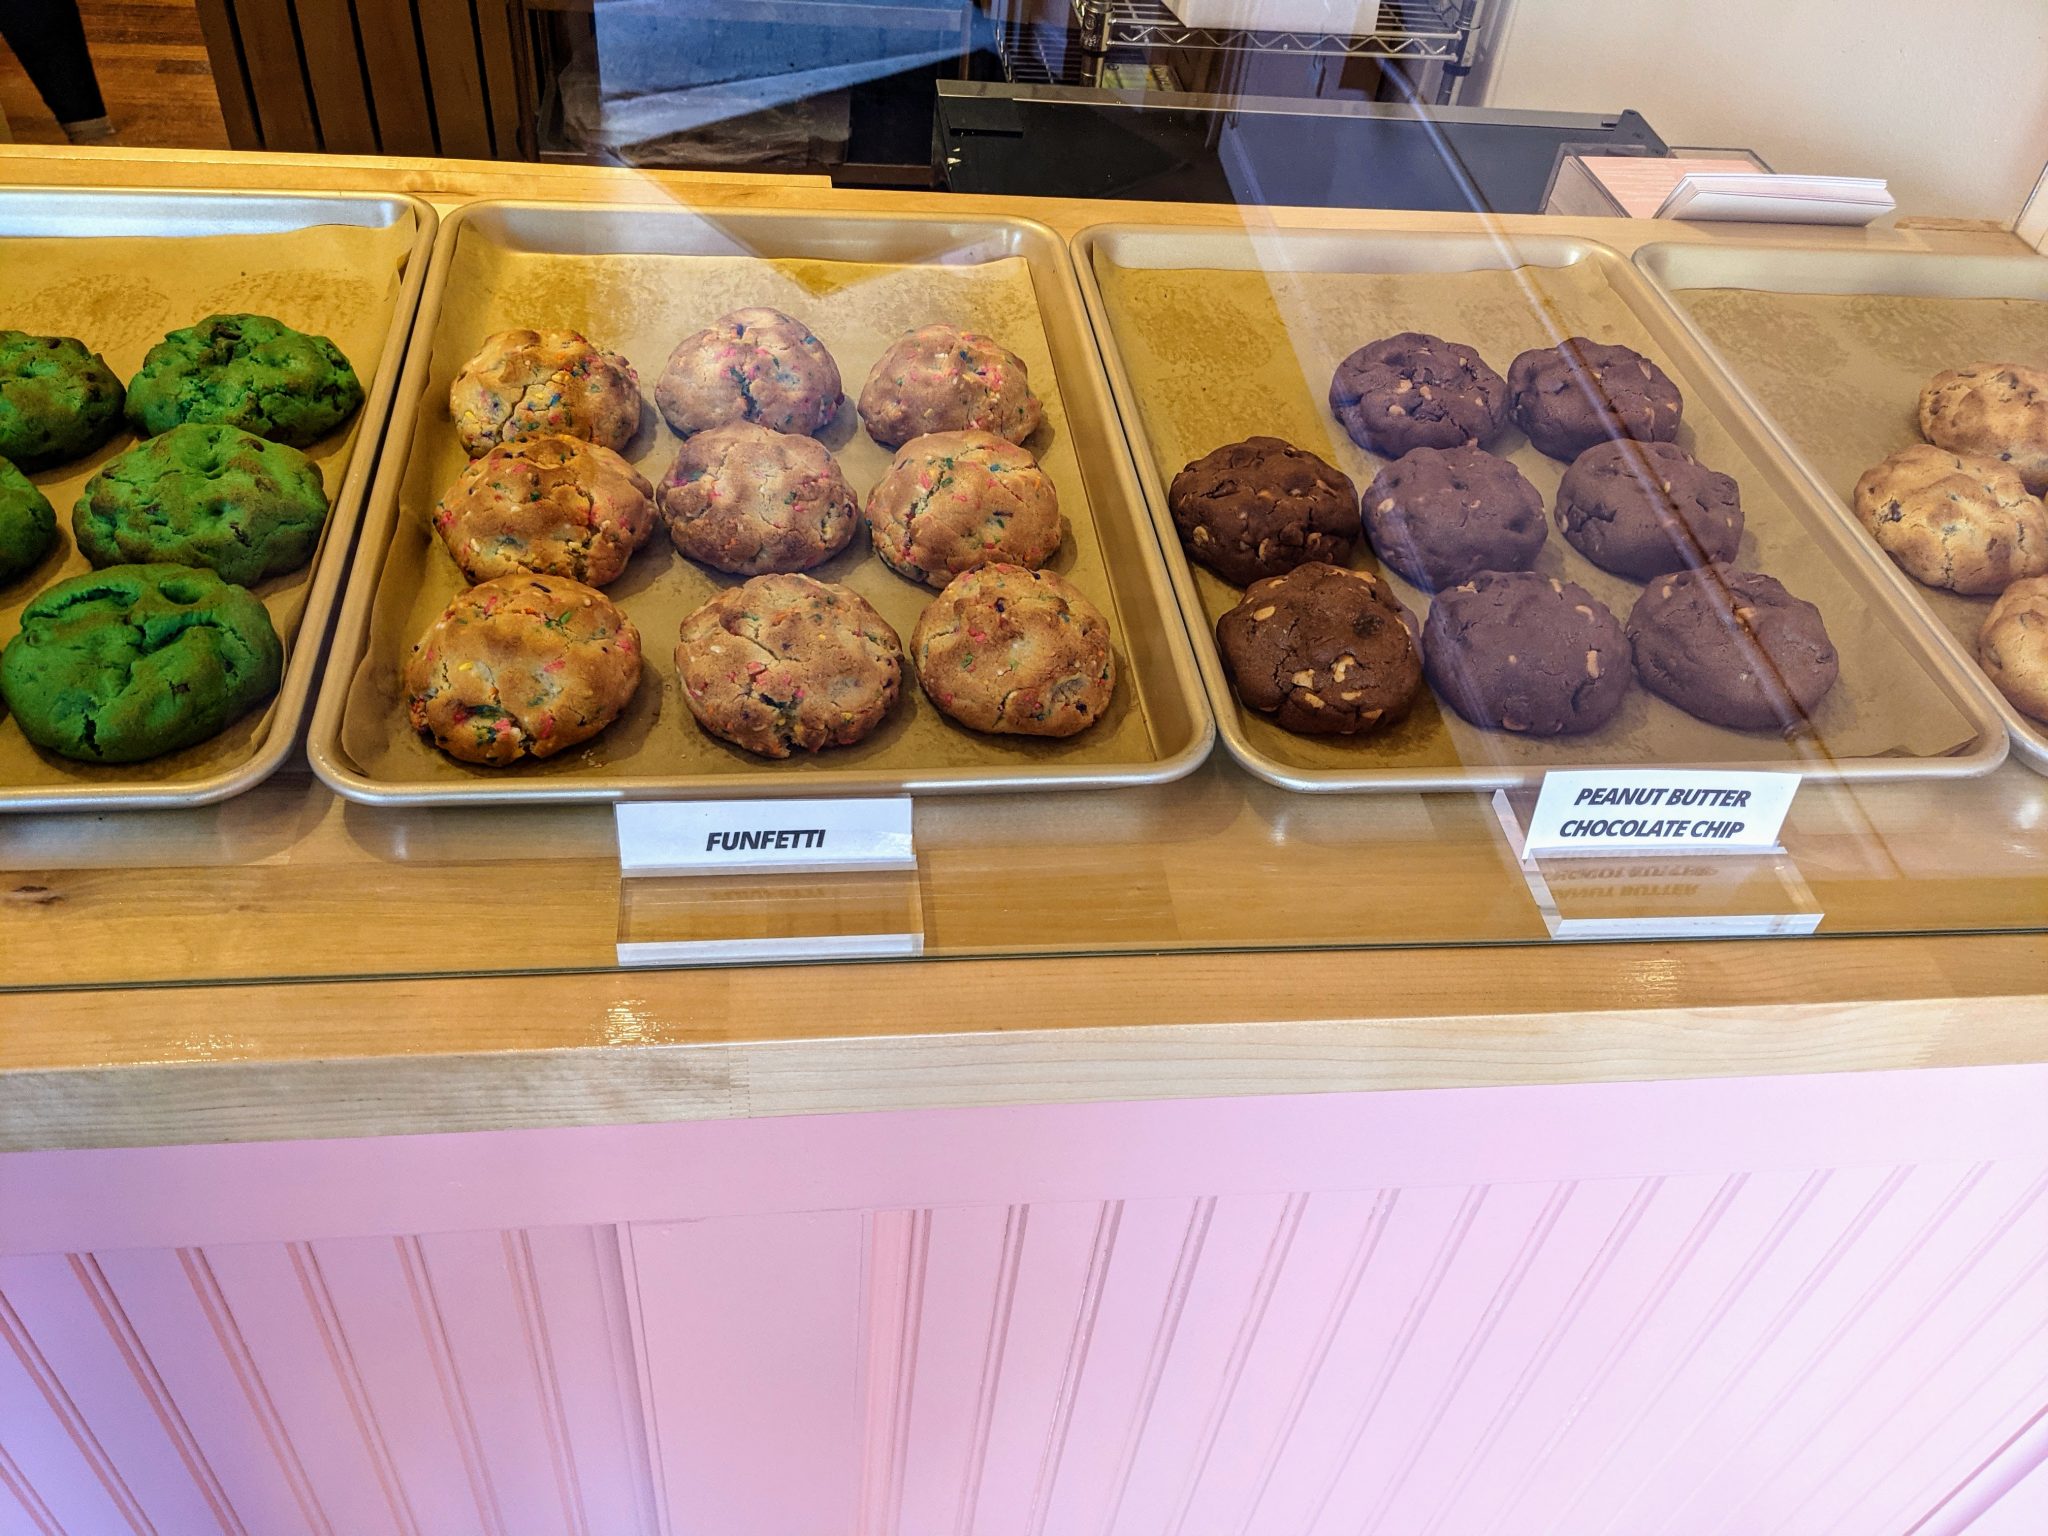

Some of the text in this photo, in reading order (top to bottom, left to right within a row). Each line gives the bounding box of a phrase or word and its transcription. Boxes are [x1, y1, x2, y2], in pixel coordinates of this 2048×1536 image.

[1574, 788, 1751, 807] PEANUT BUTTER
[1560, 819, 1745, 839] CHOCOLATE CHIP
[706, 829, 826, 851] FUNFETTI
